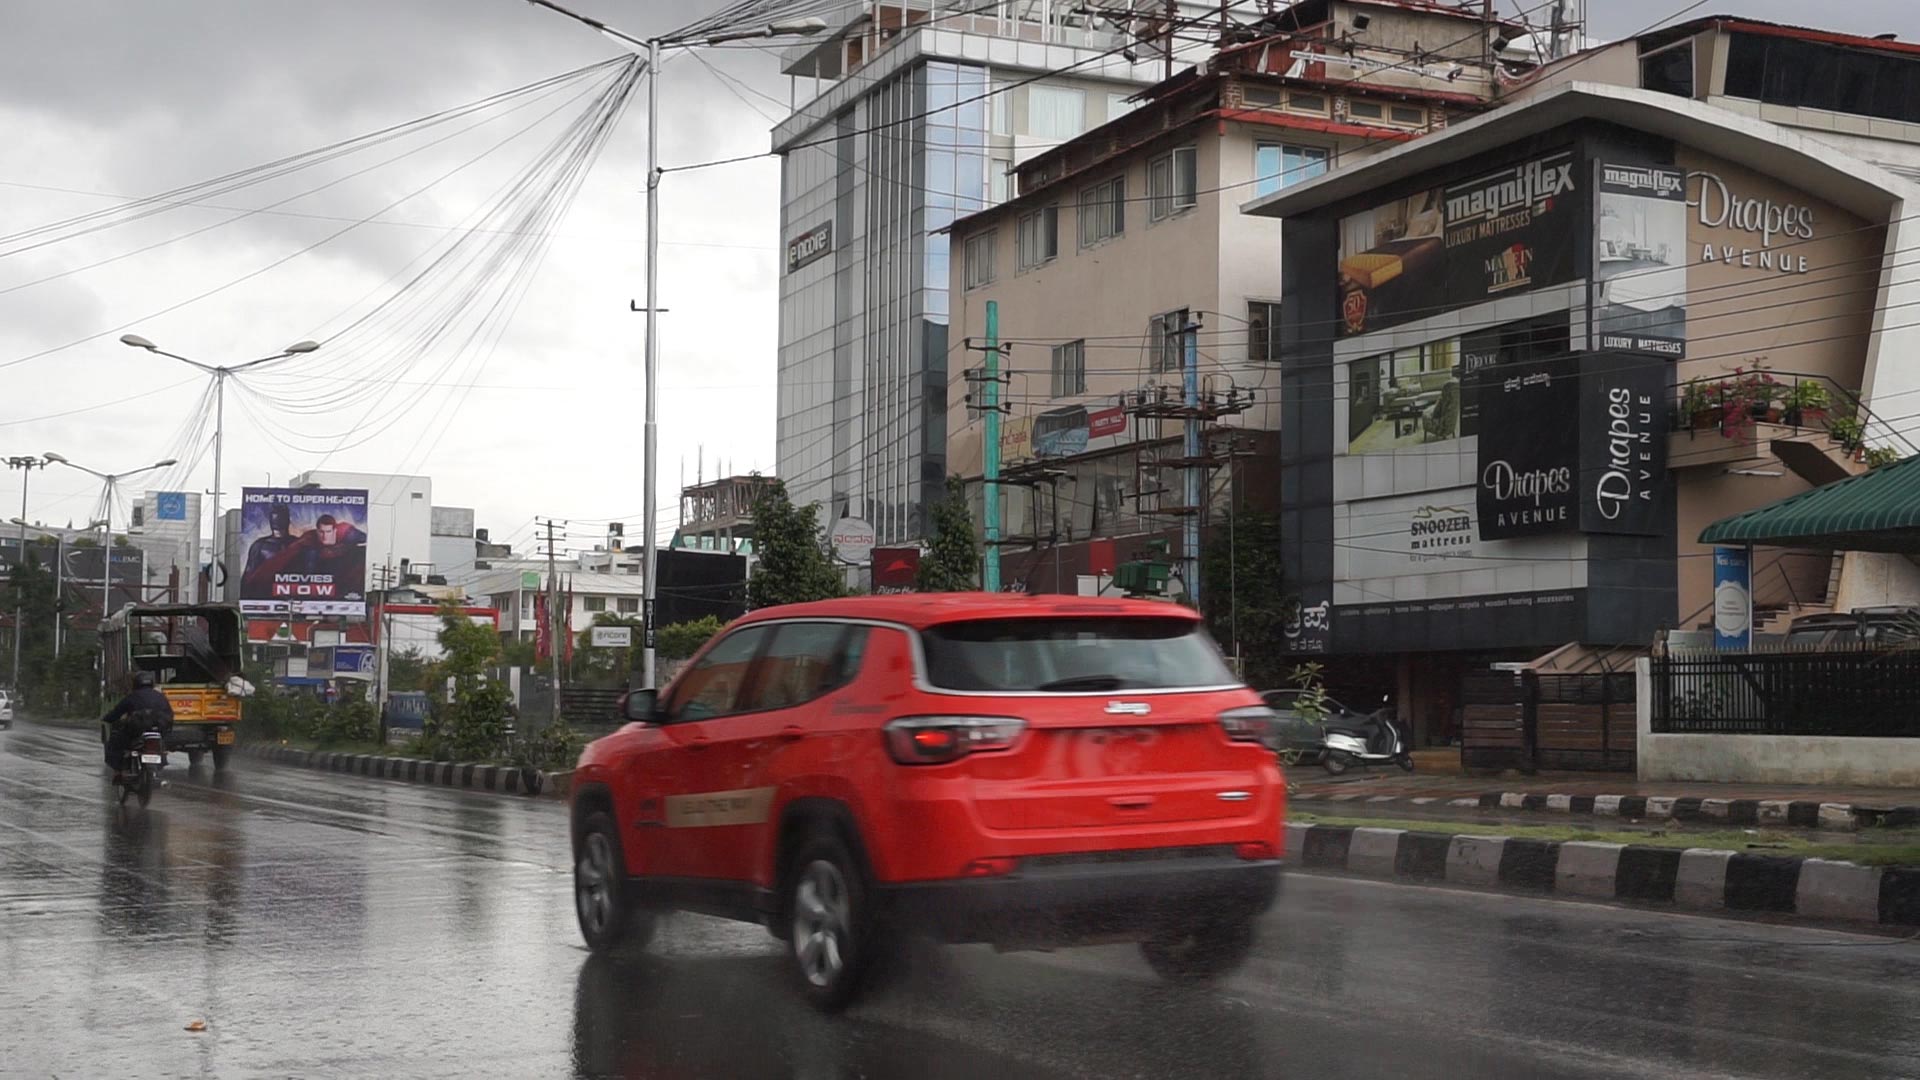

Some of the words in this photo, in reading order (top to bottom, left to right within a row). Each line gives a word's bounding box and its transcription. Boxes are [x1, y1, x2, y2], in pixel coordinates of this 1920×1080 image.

[1446, 161, 1575, 221] magniflex
[1604, 169, 1682, 192] magniflex
[1686, 171, 1813, 247] Drapes
[1446, 225, 1478, 249] LUXURY
[1479, 209, 1531, 238] MATTRESSES
[1703, 244, 1808, 272] AVENUE
[1604, 336, 1632, 349] LUXURY
[1638, 339, 1681, 353] MATTRESSES
[1597, 388, 1638, 519] Drapes
[1639, 395, 1651, 500] AVENUE
[1483, 460, 1570, 507] Drapes
[245, 494, 275, 503] HOME
[278, 495, 290, 503] TO
[292, 495, 325, 504] SUPER
[1411, 516, 1470, 536] SNOOZER
[1498, 506, 1566, 527] AVENUE
[1411, 535, 1471, 549] mattress
[275, 574, 333, 583] MOVIES
[276, 584, 333, 595] NOW
